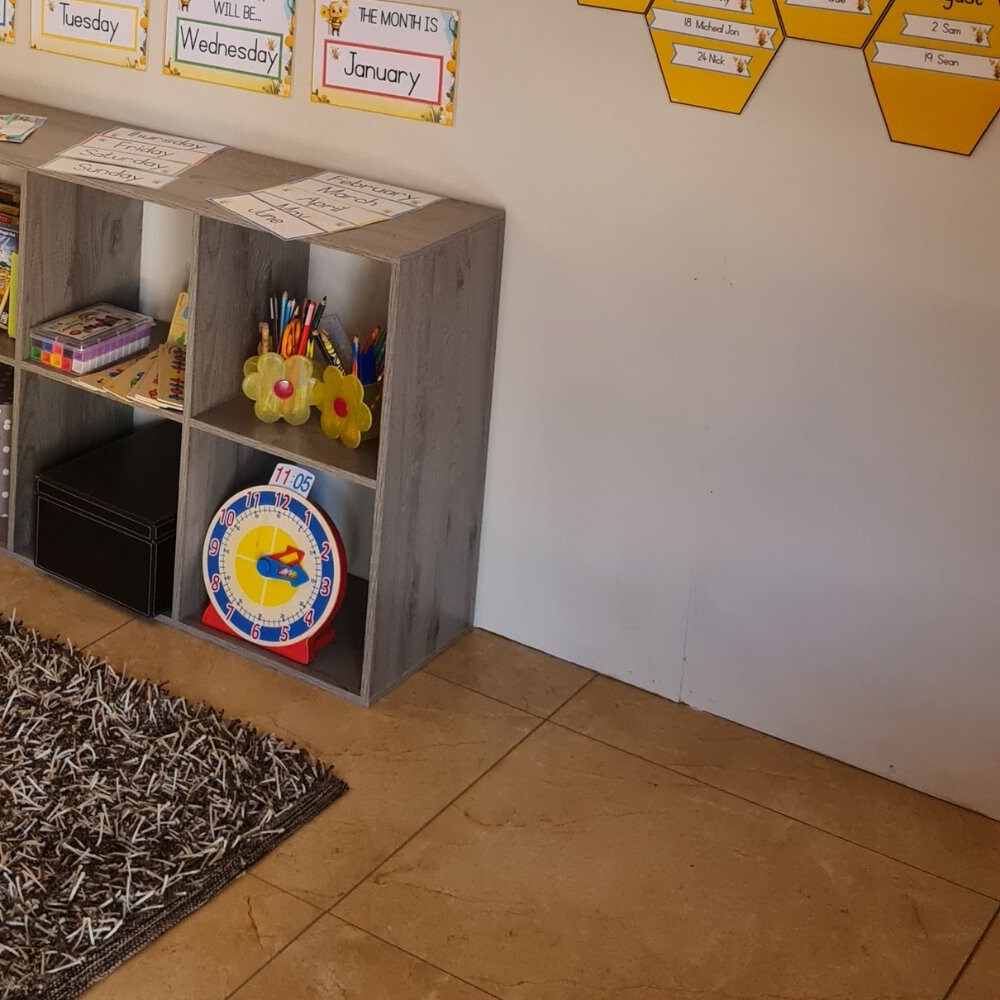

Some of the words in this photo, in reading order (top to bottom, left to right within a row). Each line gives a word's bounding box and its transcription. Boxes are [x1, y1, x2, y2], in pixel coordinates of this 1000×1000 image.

[214, 0, 240, 18] WILL
[59, 2, 119, 42] Tuesday
[358, 7, 378, 24] THE
[381, 10, 421, 30] MONTH
[424, 16, 438, 32] IS
[725, 25, 739, 36] Jon
[942, 23, 961, 35] Sam
[179, 24, 279, 68] Wednesday
[698, 51, 707, 61] 24
[709, 53, 725, 65] Nick
[938, 54, 959, 66] Sean
[343, 51, 420, 96] January
[114, 141, 176, 157] Friday
[80, 148, 169, 170] Saturday
[73, 163, 144, 182] Sunday
[318, 186, 377, 207] March
[327, 175, 421, 201] February
[248, 207, 284, 224] June
[274, 466, 313, 492] 11:05
[245, 491, 260, 509] 11
[275, 492, 291, 511] 12
[221, 509, 235, 527] 10
[305, 511, 312, 527] 1
[209, 540, 220, 555] 9
[321, 543, 330, 561] 2
[211, 575, 220, 591] 8
[320, 579, 331, 596] 3
[226, 605, 235, 620] 7
[304, 609, 314, 627] 4
[252, 624, 261, 639] 6
[281, 626, 289, 642] 5
